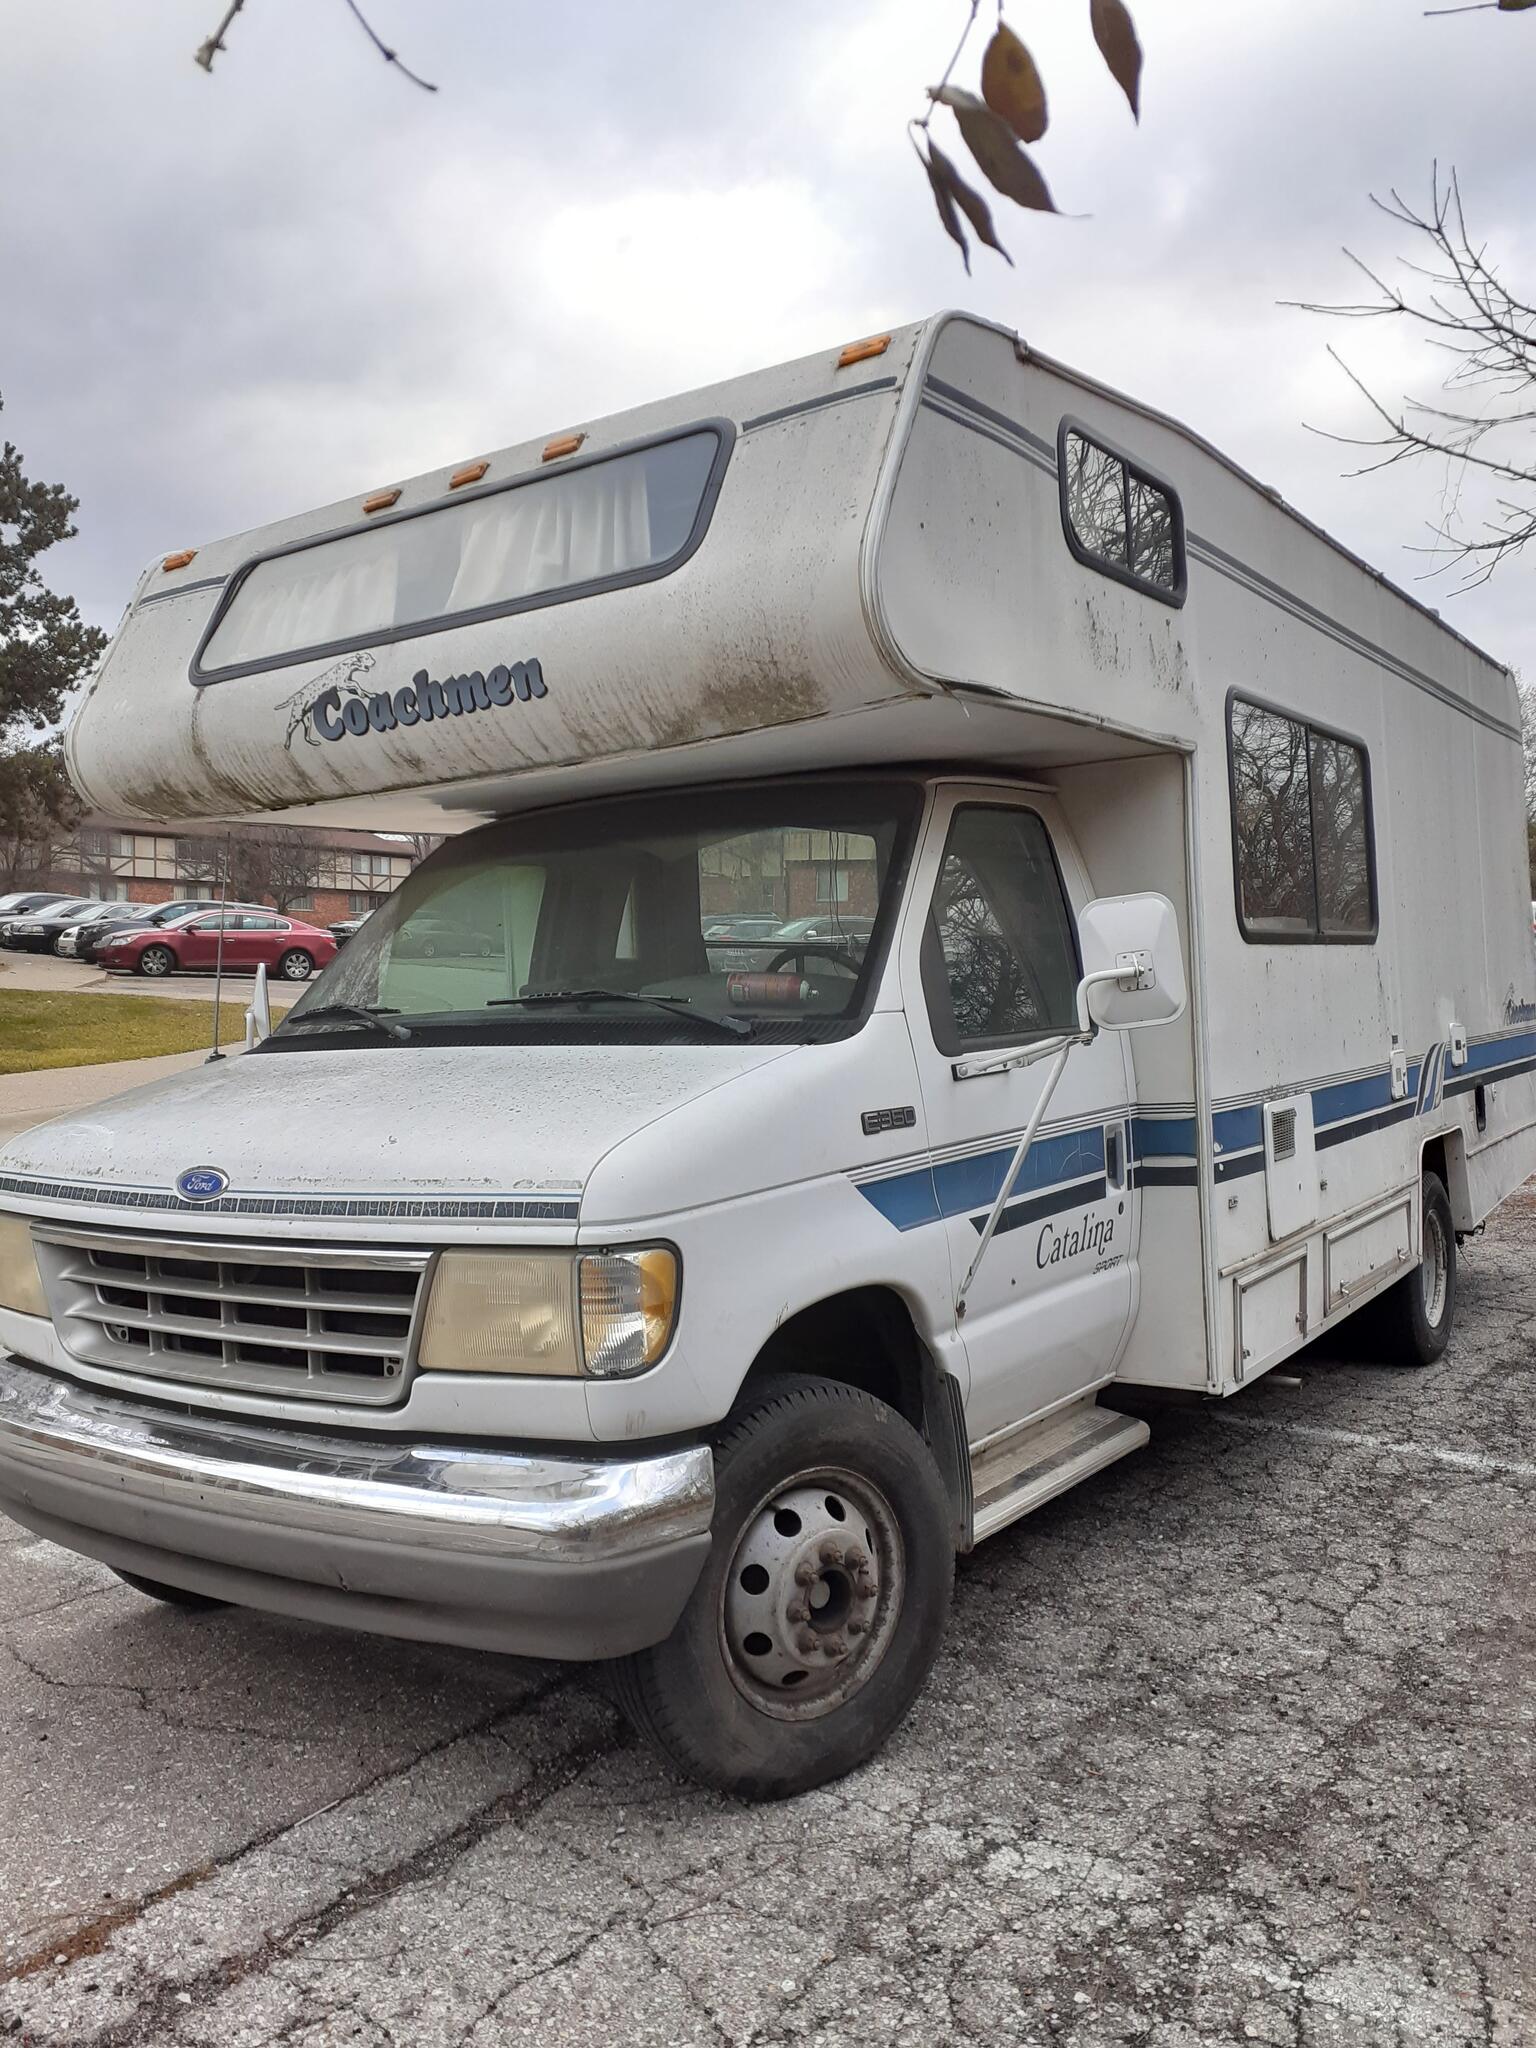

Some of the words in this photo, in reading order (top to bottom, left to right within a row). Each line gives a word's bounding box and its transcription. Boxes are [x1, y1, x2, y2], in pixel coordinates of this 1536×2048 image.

[312, 657, 548, 741] Coachmen
[186, 1174, 217, 1191] Ford
[1036, 1212, 1114, 1269] Catalina
